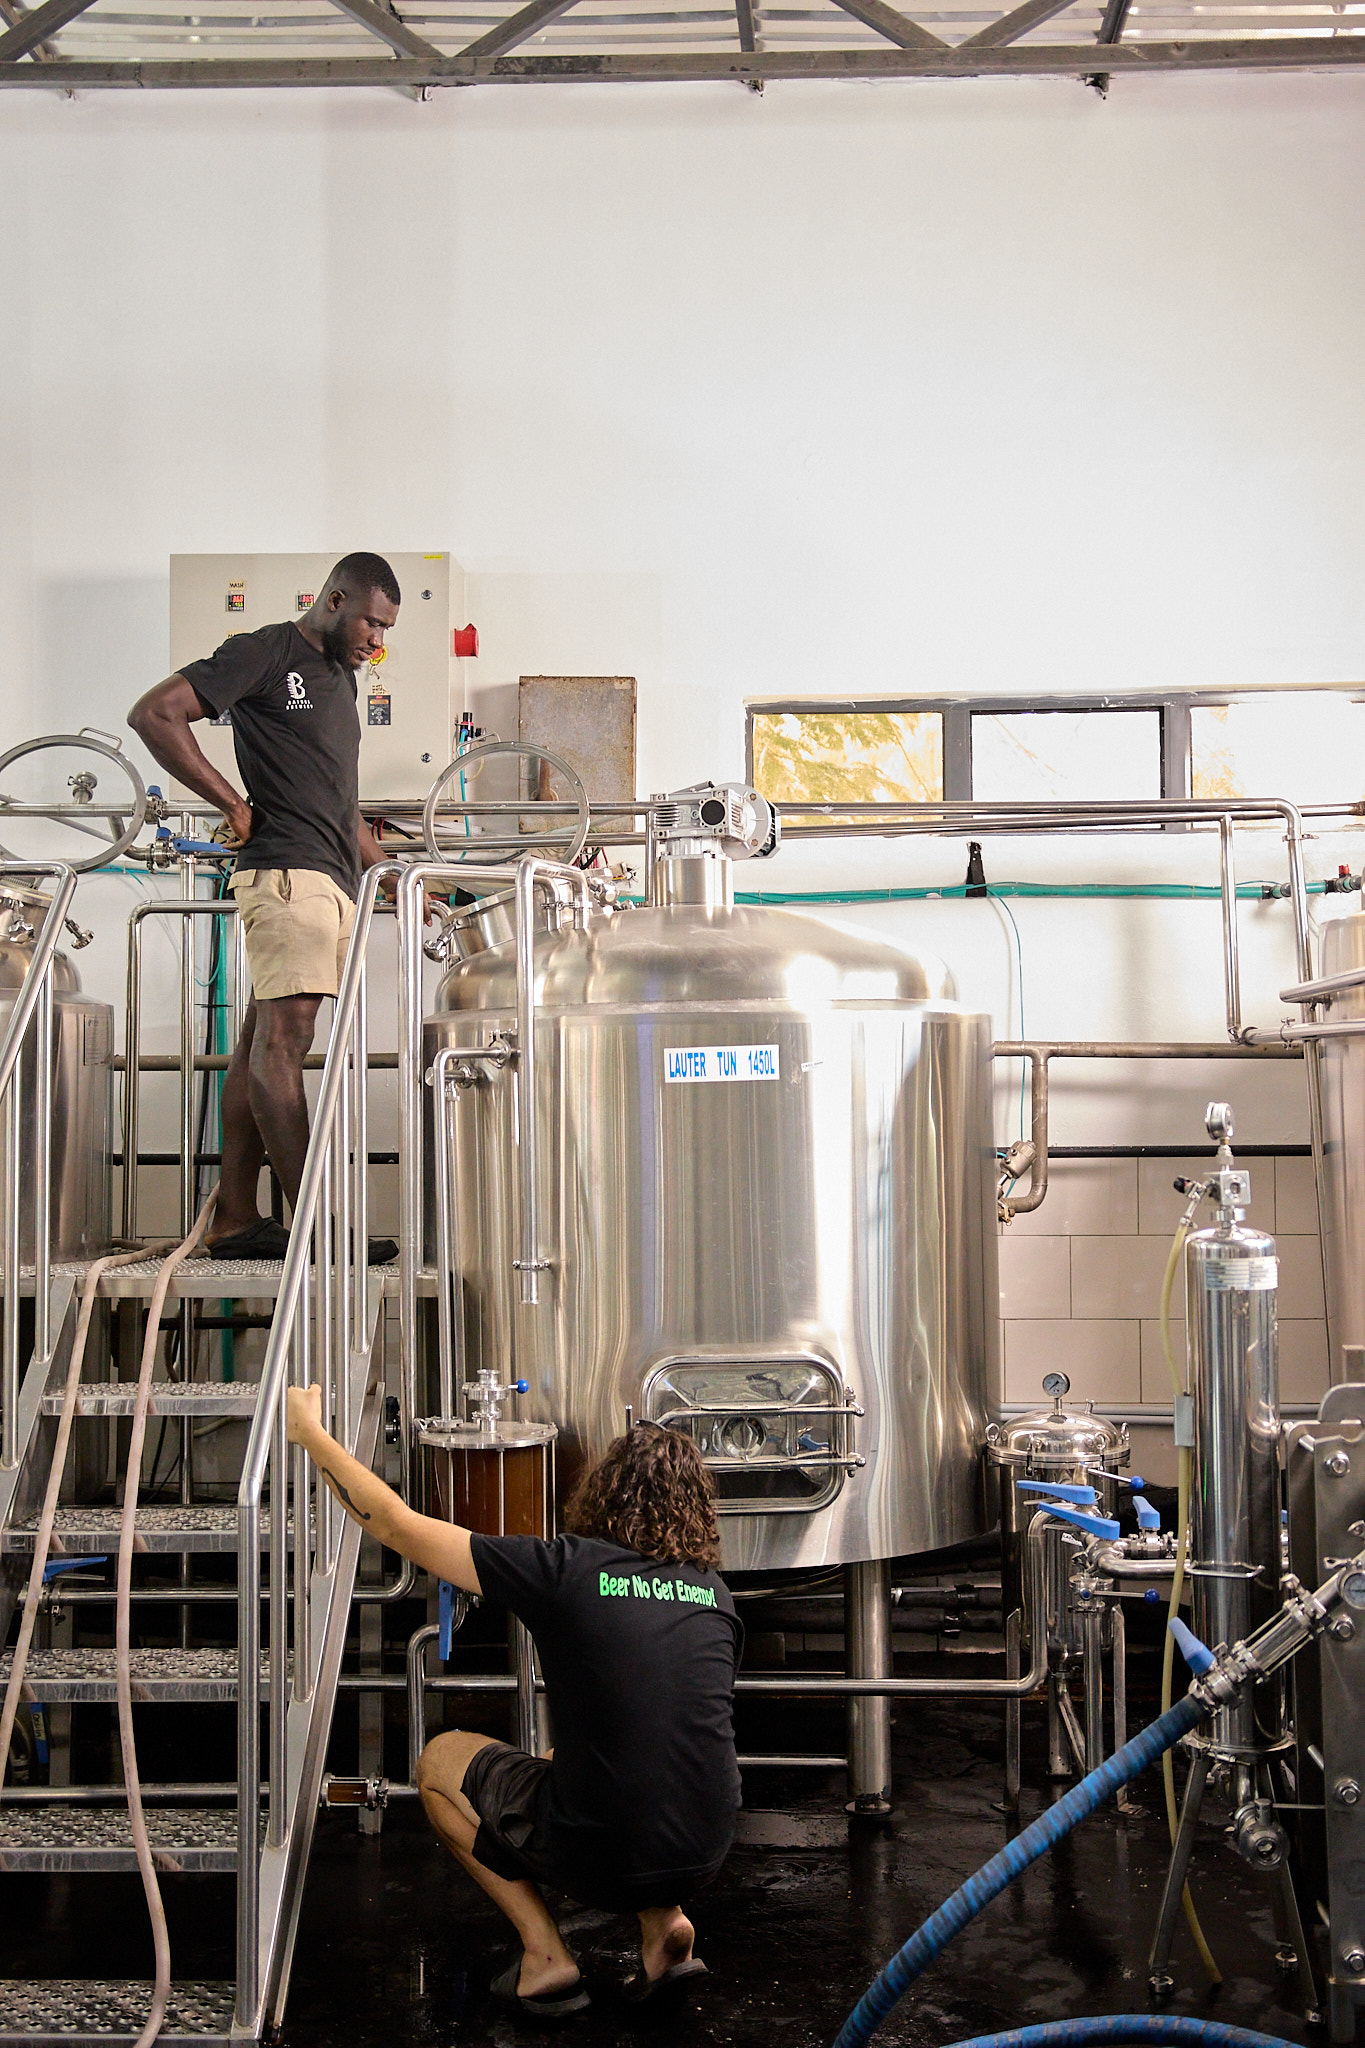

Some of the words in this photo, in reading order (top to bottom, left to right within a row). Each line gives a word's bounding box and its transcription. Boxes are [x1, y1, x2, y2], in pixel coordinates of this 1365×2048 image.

[668, 1052, 707, 1078] LAUTER
[717, 1051, 737, 1076] TUN
[748, 1050, 775, 1075] 1450L
[599, 1571, 631, 1598] Beer
[632, 1574, 652, 1600] No
[652, 1577, 675, 1602] Get
[675, 1579, 718, 1609] Enemy!
